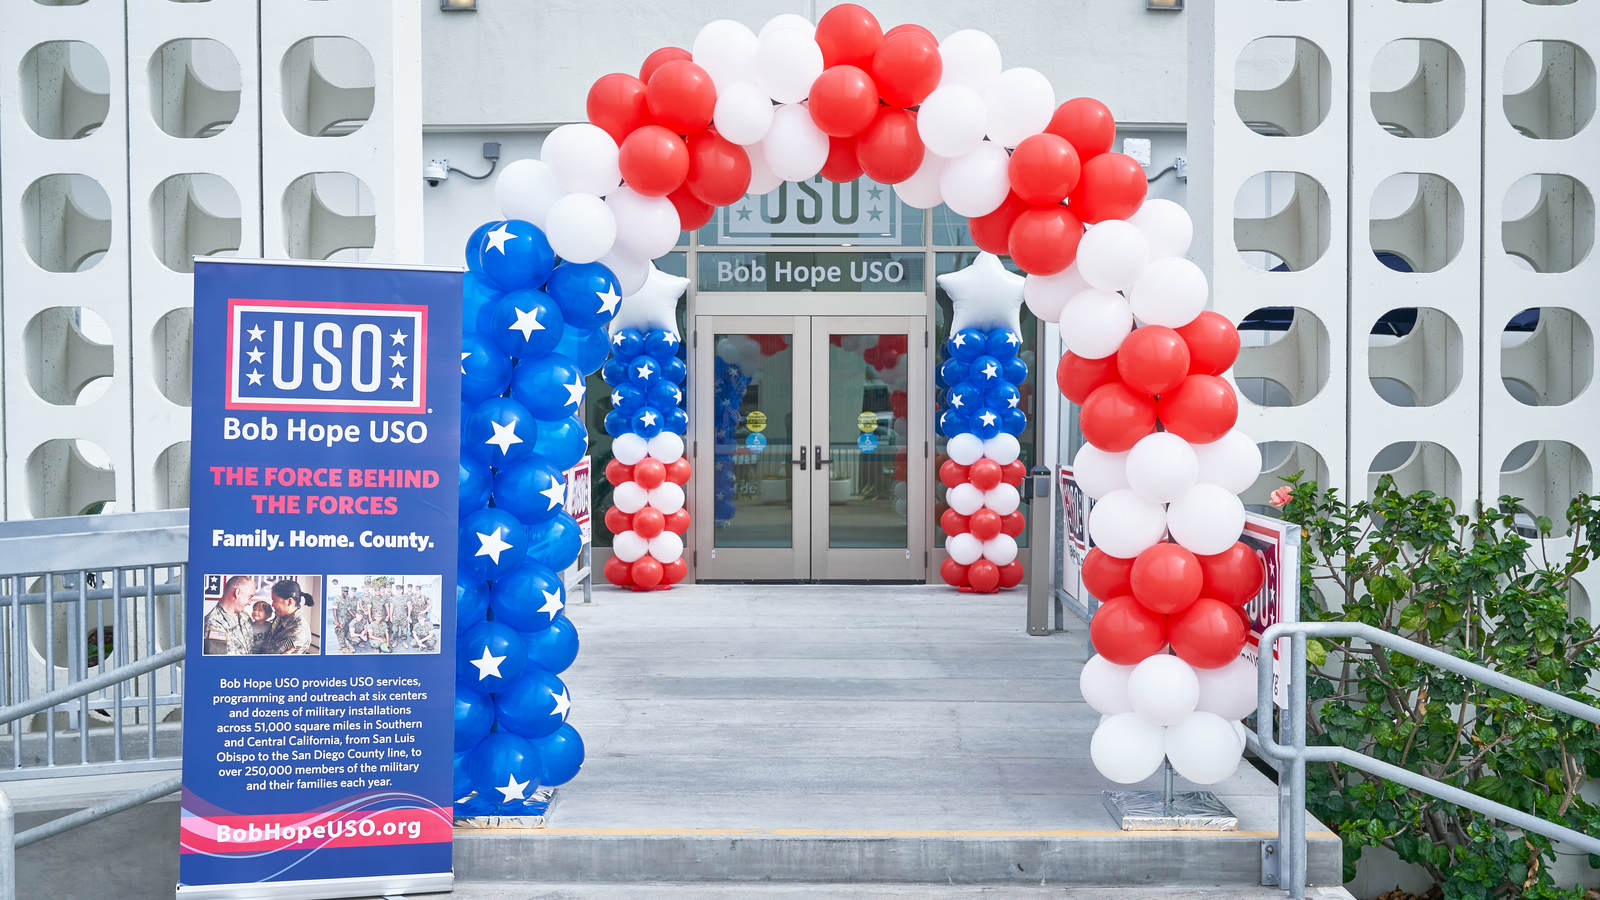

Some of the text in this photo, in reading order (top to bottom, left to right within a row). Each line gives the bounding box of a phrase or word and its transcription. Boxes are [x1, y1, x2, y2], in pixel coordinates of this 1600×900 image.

[717, 260, 904, 287] Bob Hope USO
[272, 320, 382, 393] USO
[223, 416, 428, 447] Bob Hope USO
[209, 466, 440, 489] THE FORCE BEHIND
[251, 495, 398, 515] THE FORCES
[211, 529, 434, 552] Family. Home. County.
[220, 676, 421, 690] Bob Hope USO provides USO services,
[212, 690, 428, 706] programming and outreach at six centers
[228, 705, 412, 718] and dozens of military installations
[216, 719, 423, 733] across 51,000 square miles in Southern
[223, 733, 416, 747] and Central California, from San Luis
[216, 747, 422, 763] Obispo to the San Diego County line, to
[218, 761, 420, 777] over 250,000 members of the military
[246, 777, 393, 791] and their families each year.
[216, 818, 422, 844] BobHopeUSO.org
